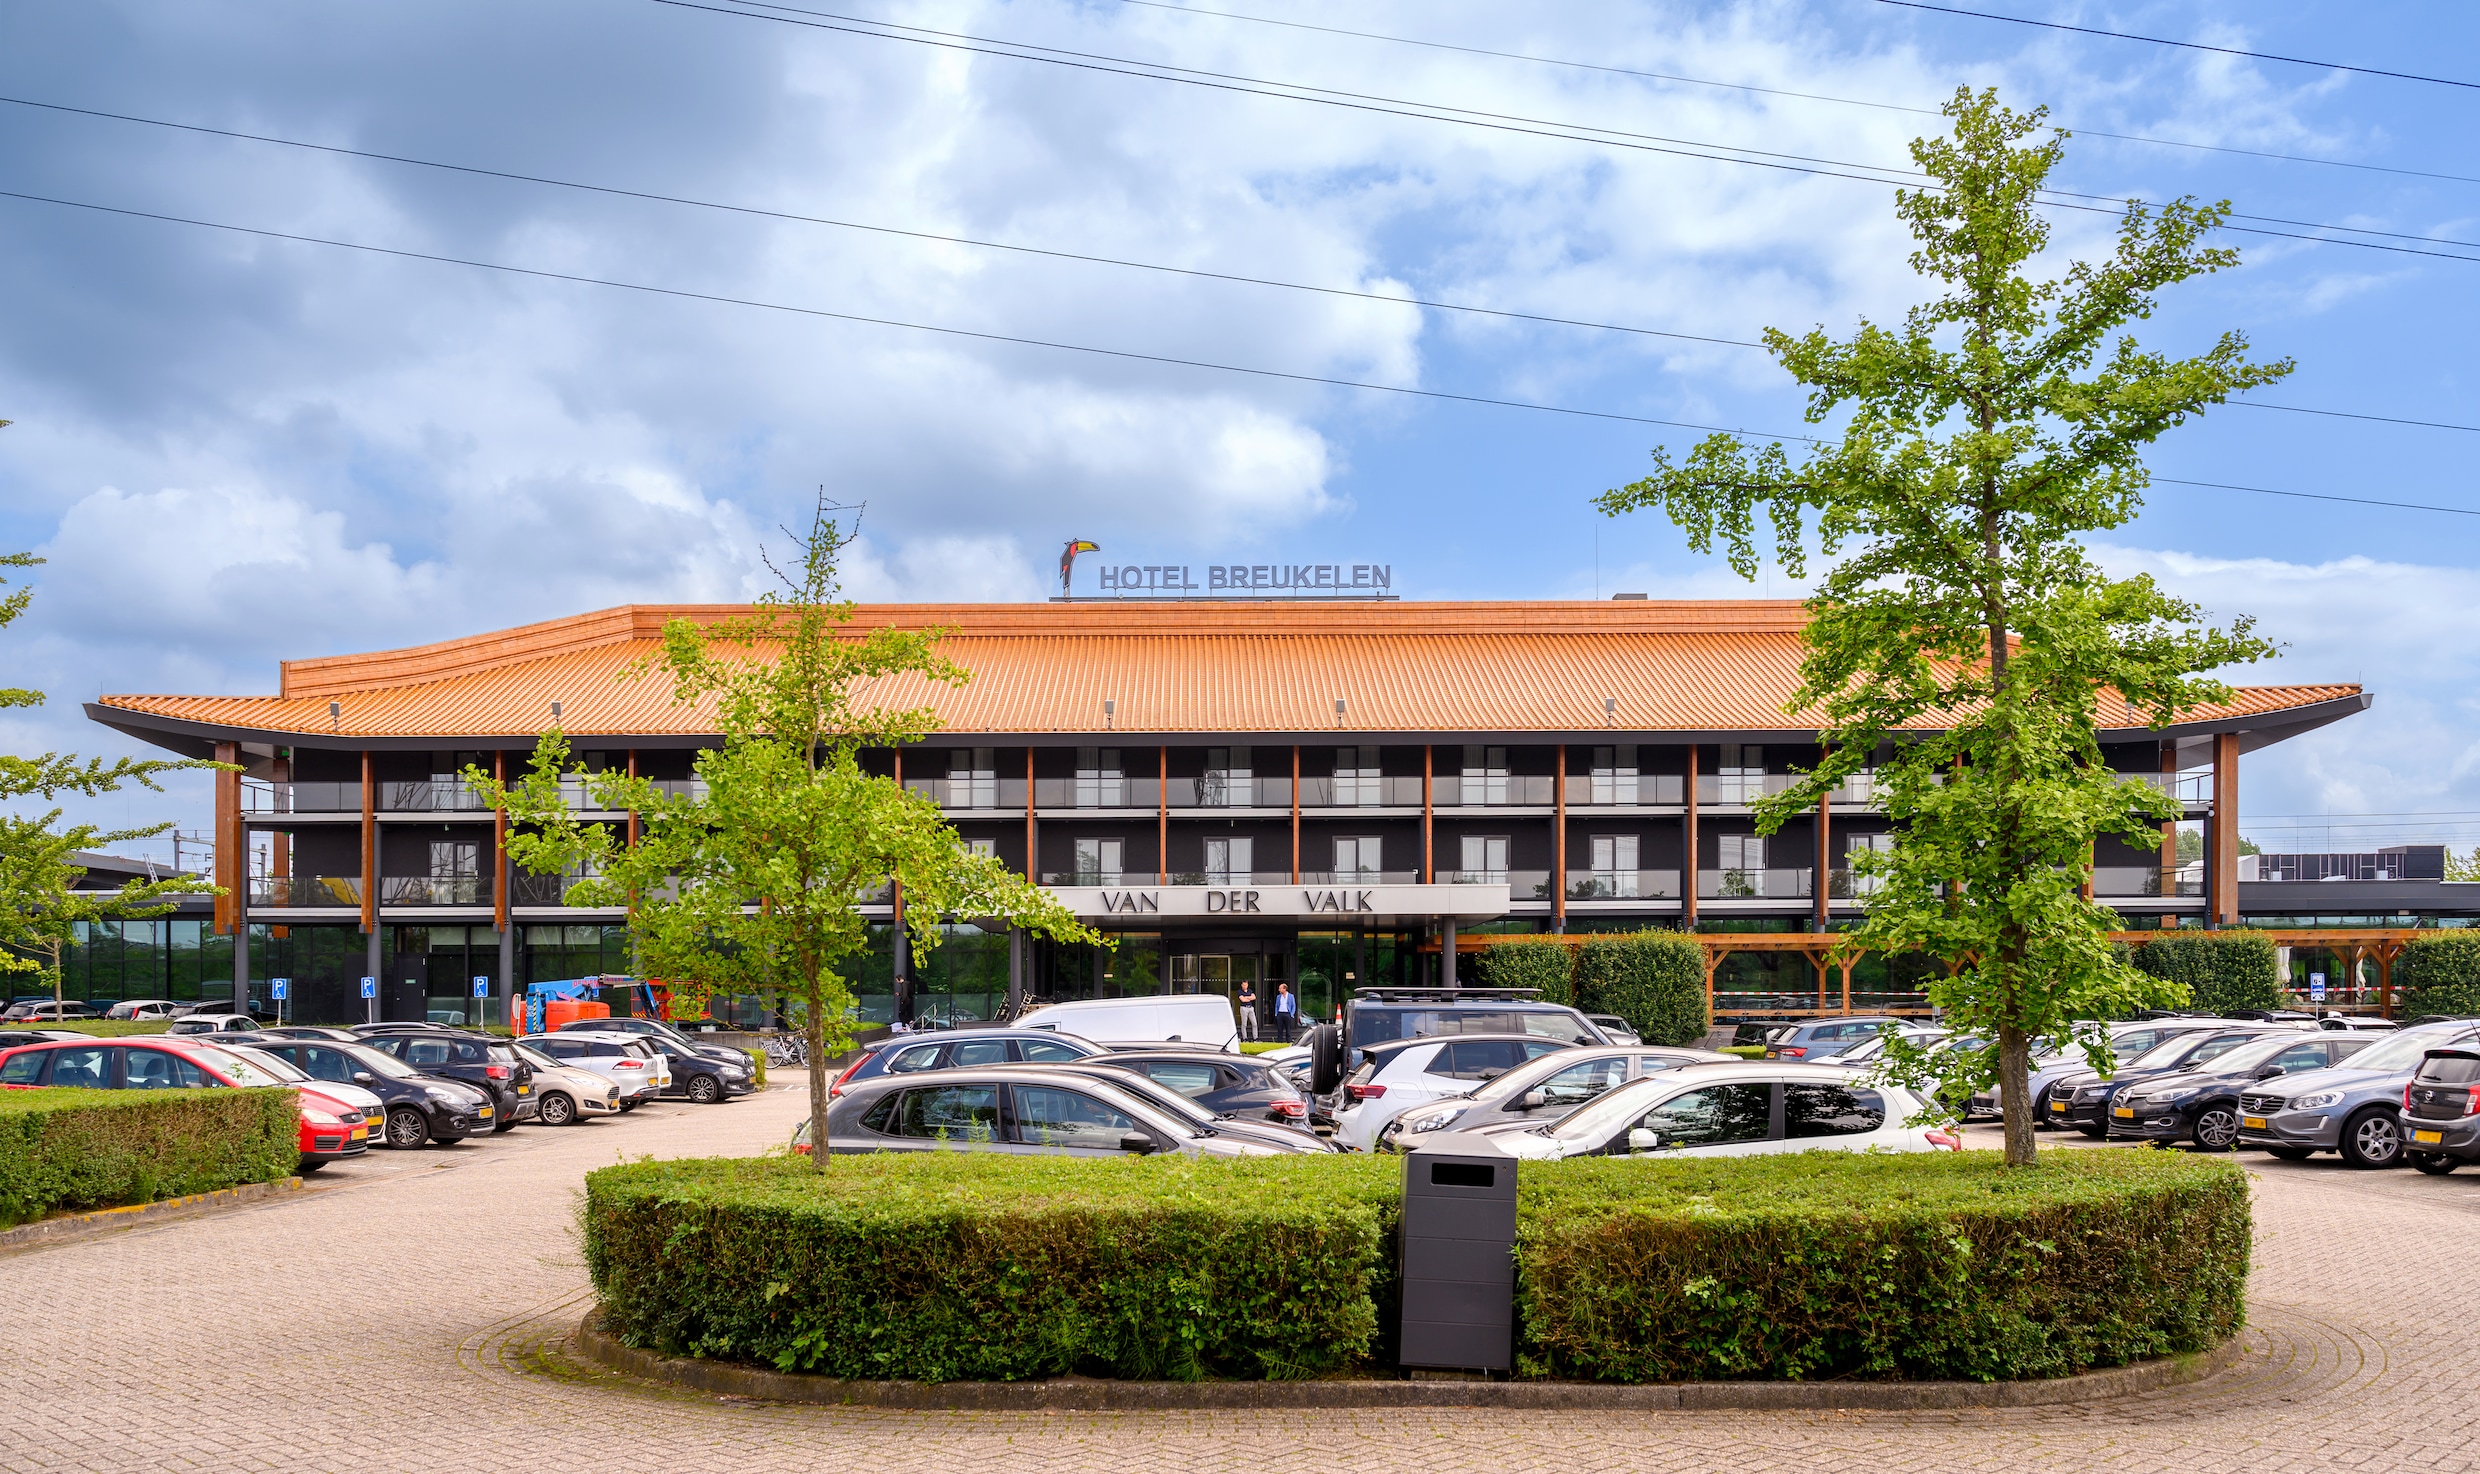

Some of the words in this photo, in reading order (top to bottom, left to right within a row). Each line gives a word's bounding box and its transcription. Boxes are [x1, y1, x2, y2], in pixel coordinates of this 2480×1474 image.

[1100, 565, 1199, 589] HOTEL
[1209, 564, 1390, 589] BREUKELEN
[1102, 891, 1159, 912] VAN
[1207, 891, 1261, 912] DER
[1304, 890, 1373, 912] VALK
[275, 980, 283, 991] P
[363, 979, 372, 990] P
[476, 978, 485, 989] P
